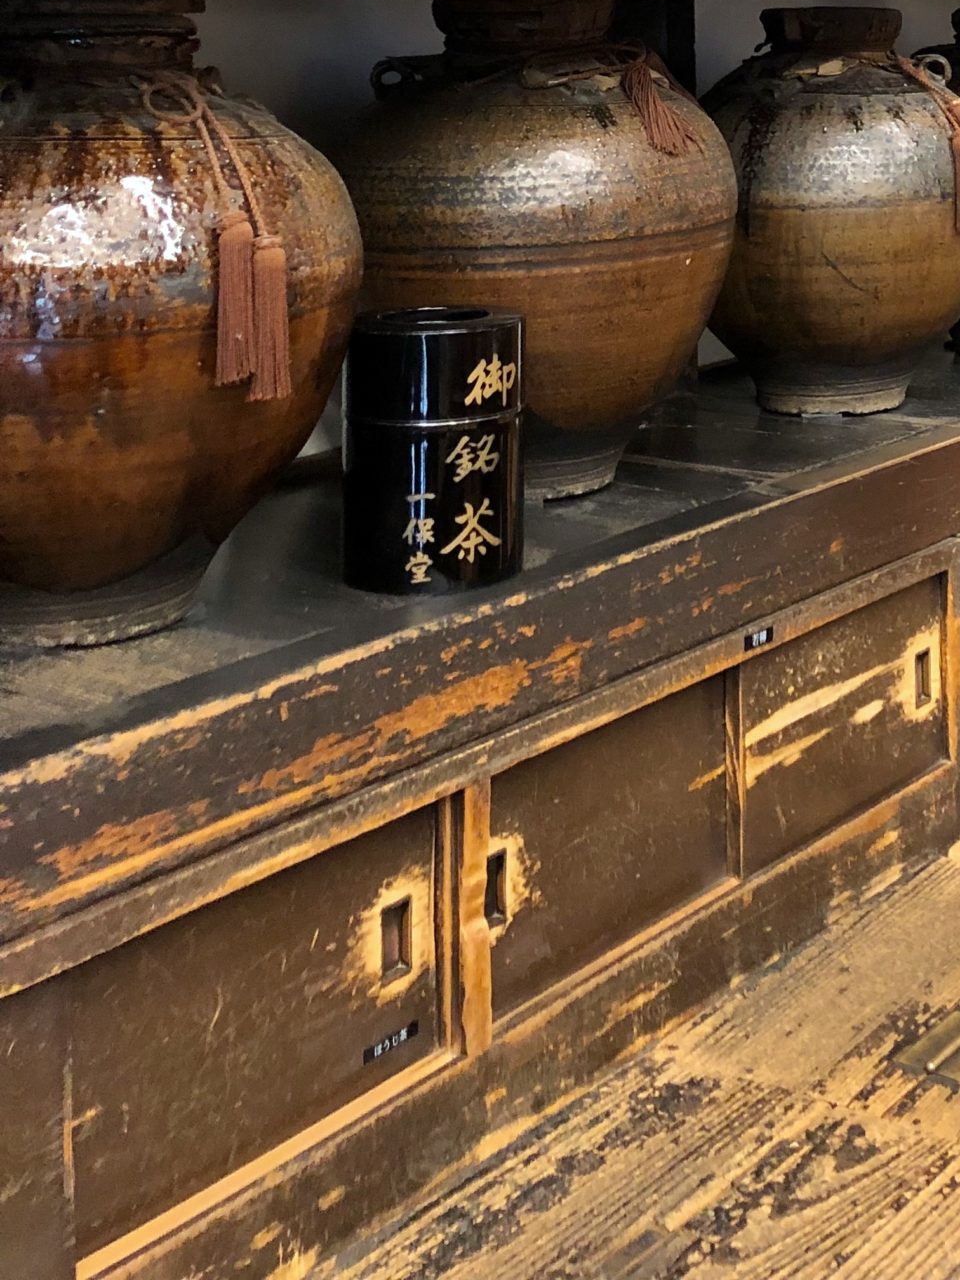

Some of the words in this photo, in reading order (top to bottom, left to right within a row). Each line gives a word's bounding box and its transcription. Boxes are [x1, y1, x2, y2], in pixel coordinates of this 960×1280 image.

[439, 353, 517, 564] 御銘茶
[402, 492, 436, 584] 一保堂
